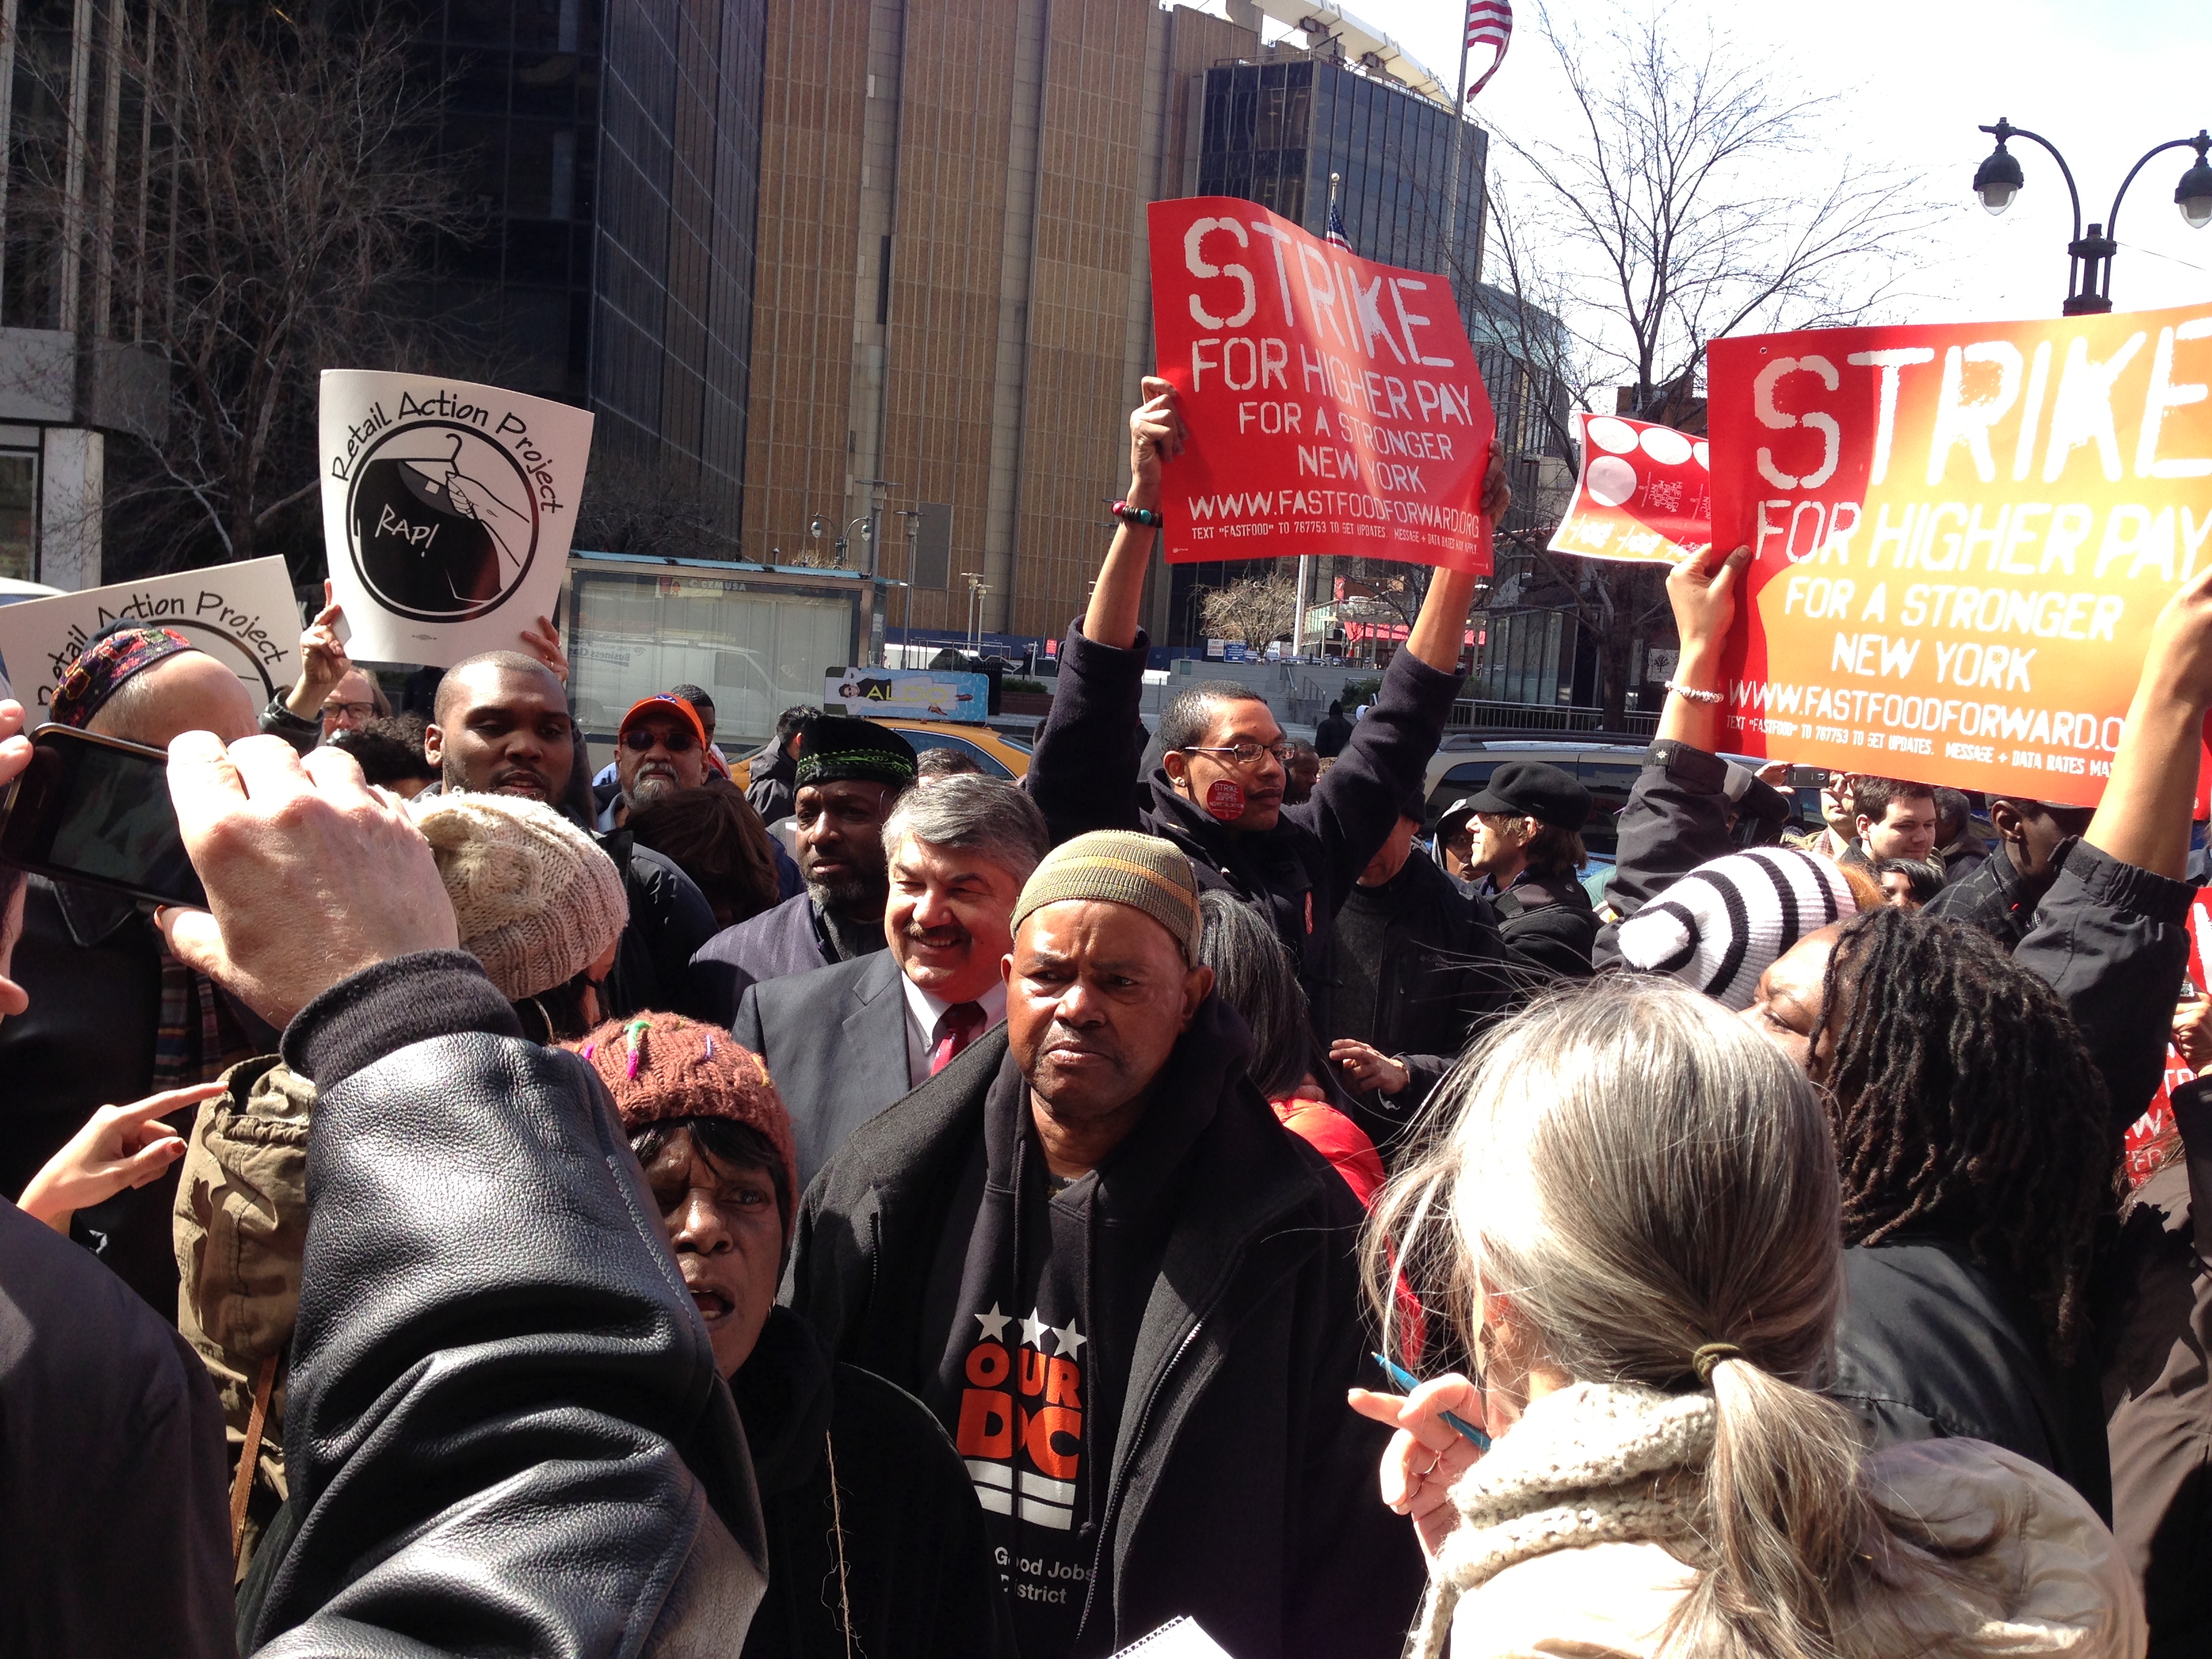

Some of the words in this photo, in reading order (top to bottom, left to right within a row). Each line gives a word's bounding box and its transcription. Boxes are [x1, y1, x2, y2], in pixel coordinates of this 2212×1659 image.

[1184, 217, 1454, 367] STRIKE
[1192, 337, 1288, 392] FOR
[1300, 344, 1412, 421] HIGHER
[1413, 380, 1473, 426] PAY
[1754, 316, 2212, 489] STRIKE
[331, 402, 392, 481] Retail
[398, 390, 489, 426] Action
[495, 412, 564, 514] Project
[1240, 401, 1300, 434] FOR
[1315, 406, 1330, 438] A
[1338, 412, 1454, 461] STRONGER
[1298, 445, 1358, 481] NEW
[1366, 462, 1426, 493] YORK
[375, 504, 439, 558] RAP!
[1189, 490, 1479, 538] WWW.FASTFOODFORWARD.ORG
[1192, 527, 1214, 539] TEXT
[1219, 523, 1274, 537] "FASTFOOD"
[1278, 522, 1289, 534] TO
[1330, 522, 1339, 533] TO
[1343, 523, 1354, 534] GET
[1357, 524, 1388, 538] UPDATES.
[1394, 528, 1419, 543] MESSAGE
[1428, 533, 1440, 546] DATA
[1441, 536, 1455, 550] RATES
[1755, 500, 1862, 565] FOR
[1867, 502, 2094, 576] HIGHER
[2094, 504, 2212, 582] PAY
[196, 591, 289, 665] Project
[1784, 577, 1855, 619] FOR
[1861, 582, 1886, 623] A
[1900, 583, 2124, 641] STRONGER
[1831, 632, 1920, 679] NEW
[1936, 640, 2036, 692] YORK
[865, 684, 947, 704] ALDO
[1727, 715, 1746, 731] TEXT
[1749, 718, 1797, 737] "FASTFOOD"
[1801, 723, 1811, 739] TO
[1853, 730, 1864, 745] TO
[1868, 733, 1885, 748] GET
[1889, 735, 1934, 755] UPDATES.
[1946, 742, 1995, 763] MESSAGE
[2012, 750, 2041, 769] DATA
[2046, 755, 2085, 775] RATES
[1214, 783, 1239, 794] STRIKE
[966, 1343, 1082, 1409] OUR
[956, 1388, 1082, 1479] DC
[1048, 1561, 1094, 1582] Jobs
